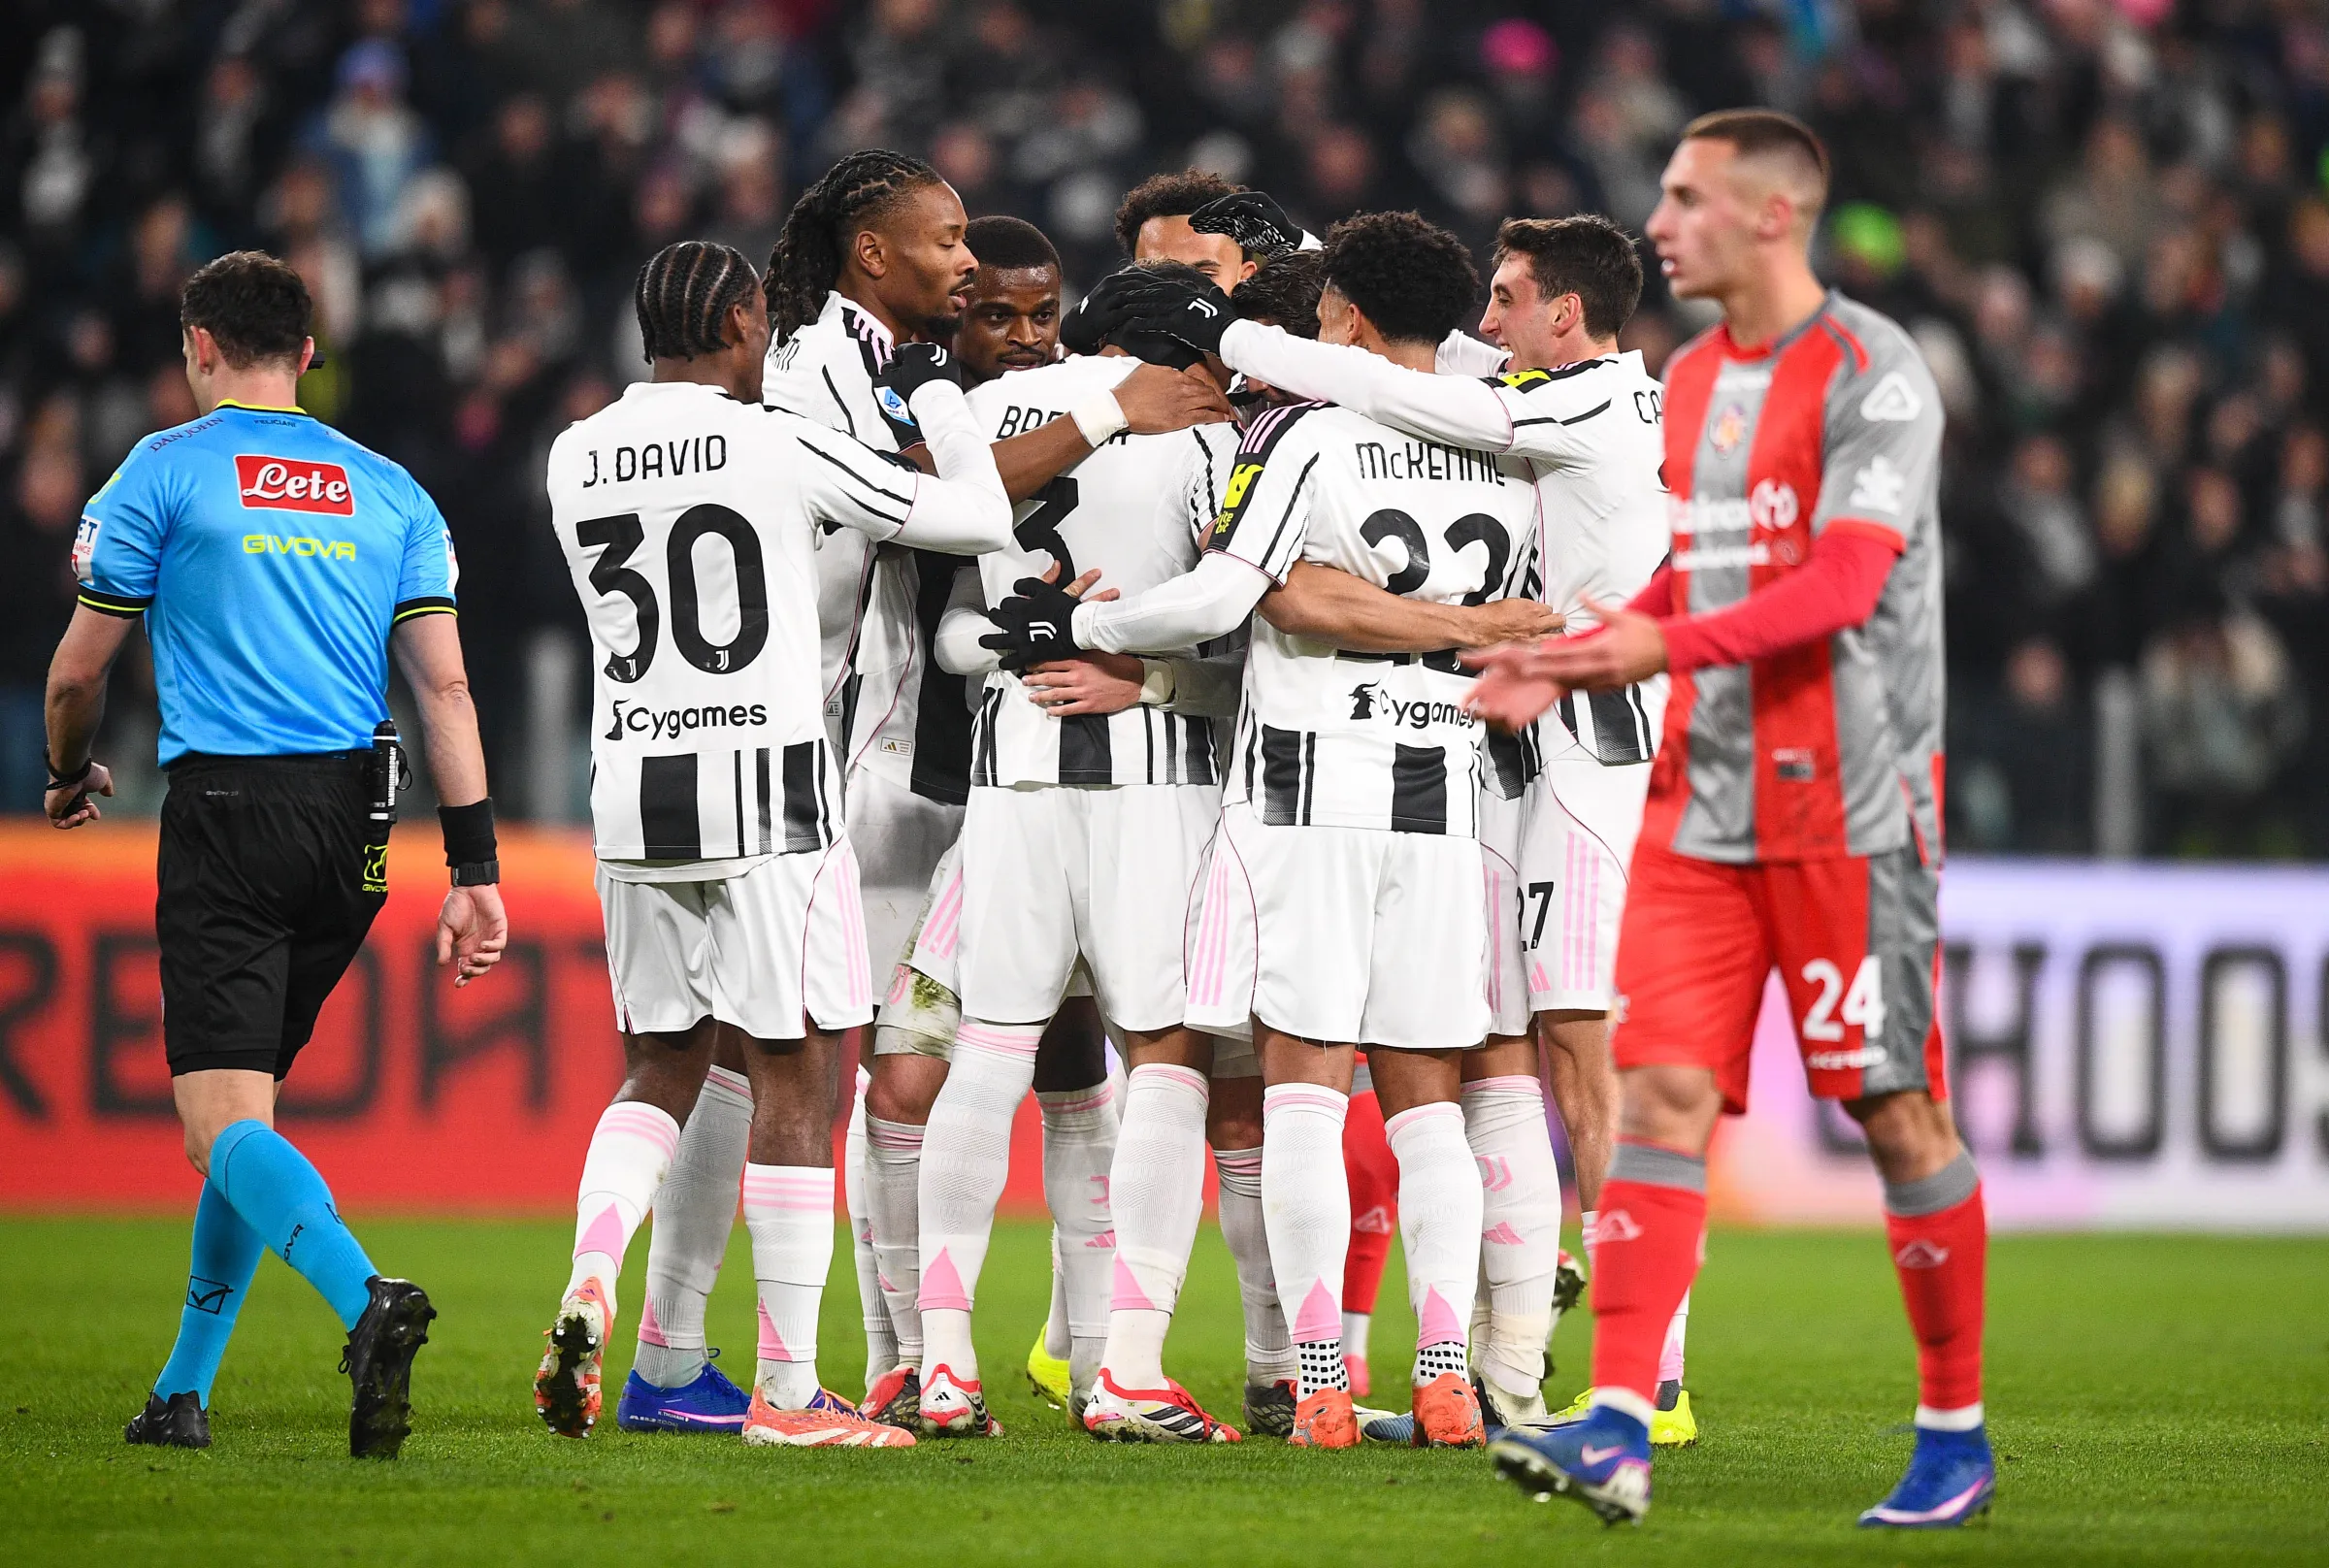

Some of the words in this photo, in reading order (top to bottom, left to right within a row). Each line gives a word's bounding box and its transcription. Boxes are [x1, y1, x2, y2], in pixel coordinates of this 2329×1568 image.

[149, 432, 184, 452] DAN
[184, 416, 224, 439] JOHN
[242, 463, 348, 504] Lete
[242, 534, 356, 562] GIVOVA
[575, 503, 770, 684] 30
[626, 703, 768, 740] Cygames
[1801, 955, 1888, 1042] 24
